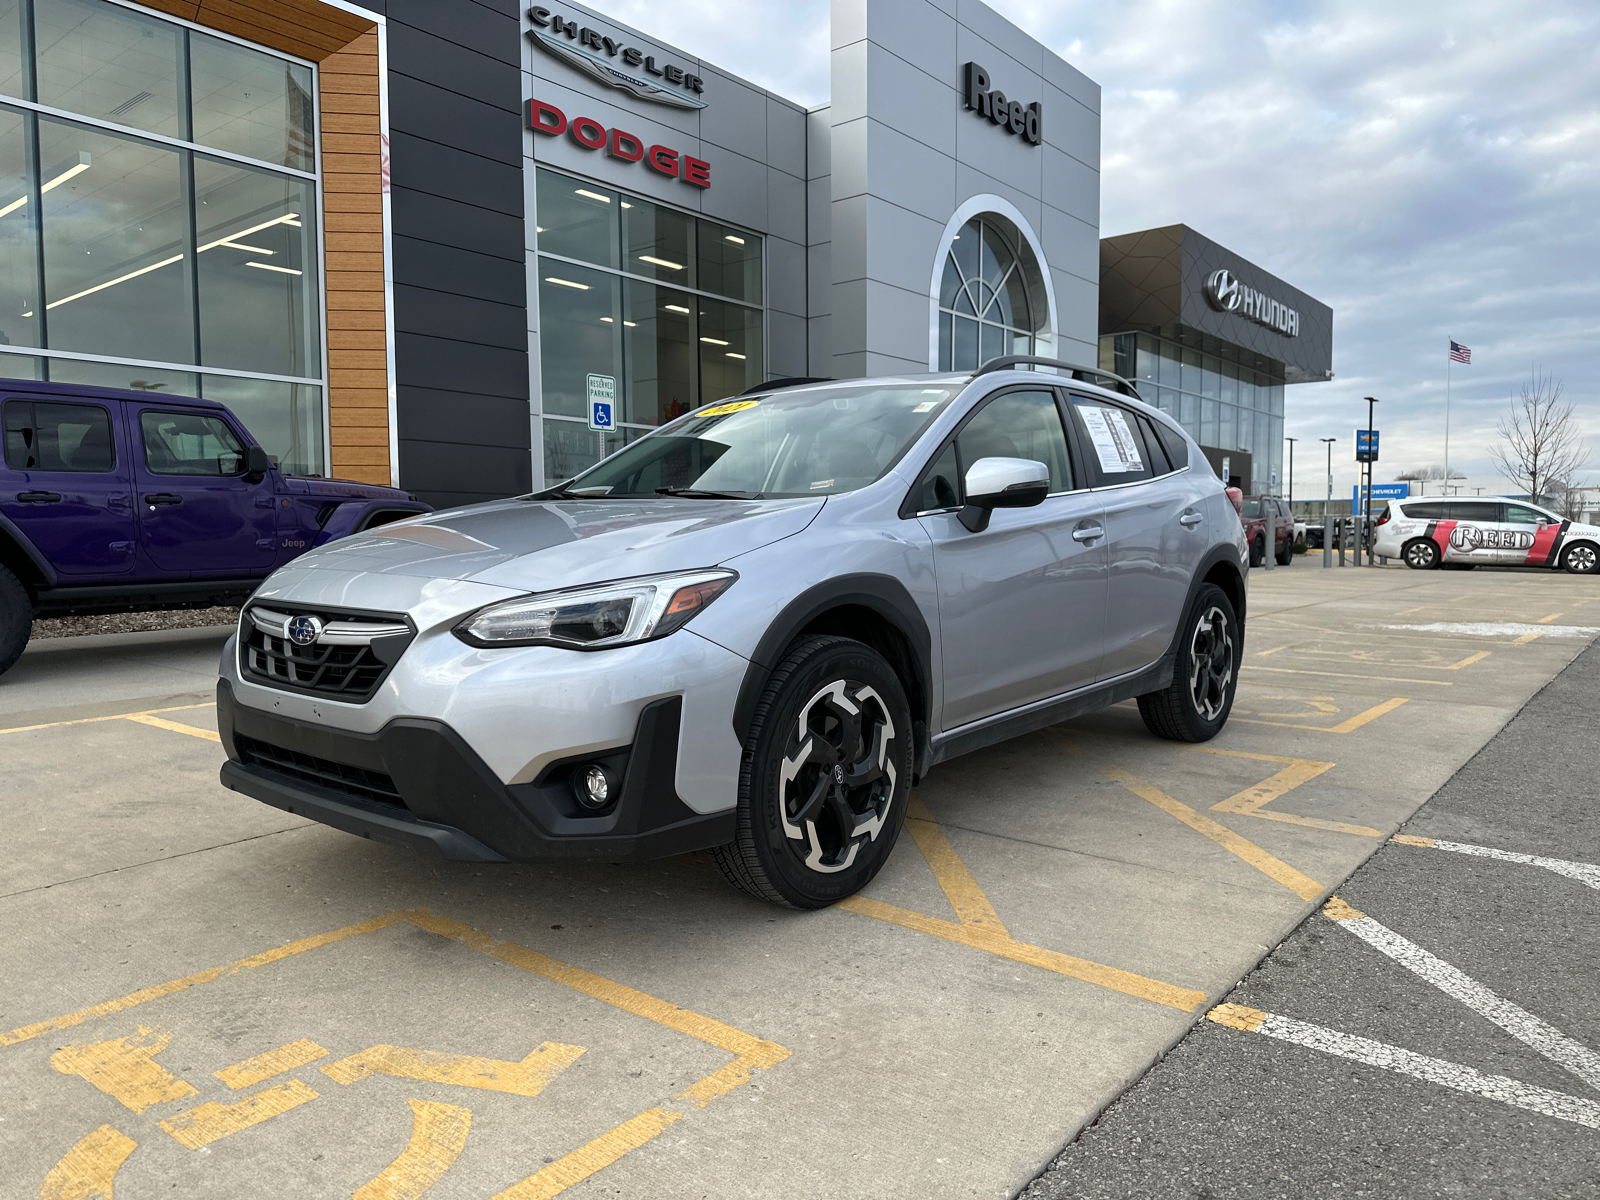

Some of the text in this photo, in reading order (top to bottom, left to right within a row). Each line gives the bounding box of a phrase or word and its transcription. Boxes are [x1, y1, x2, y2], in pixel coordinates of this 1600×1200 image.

[529, 6, 705, 94] CHRYSLER
[965, 61, 1042, 146] Reed
[525, 98, 711, 189] DODGE
[1240, 284, 1299, 337] HYUNDAI
[590, 380, 613, 390] RESERVED
[590, 389, 614, 399] PARKING
[282, 539, 305, 548] Jeep
[1452, 525, 1534, 551] REED
[905, 728, 913, 790] KUMHO
[767, 757, 778, 831] KUMHO
